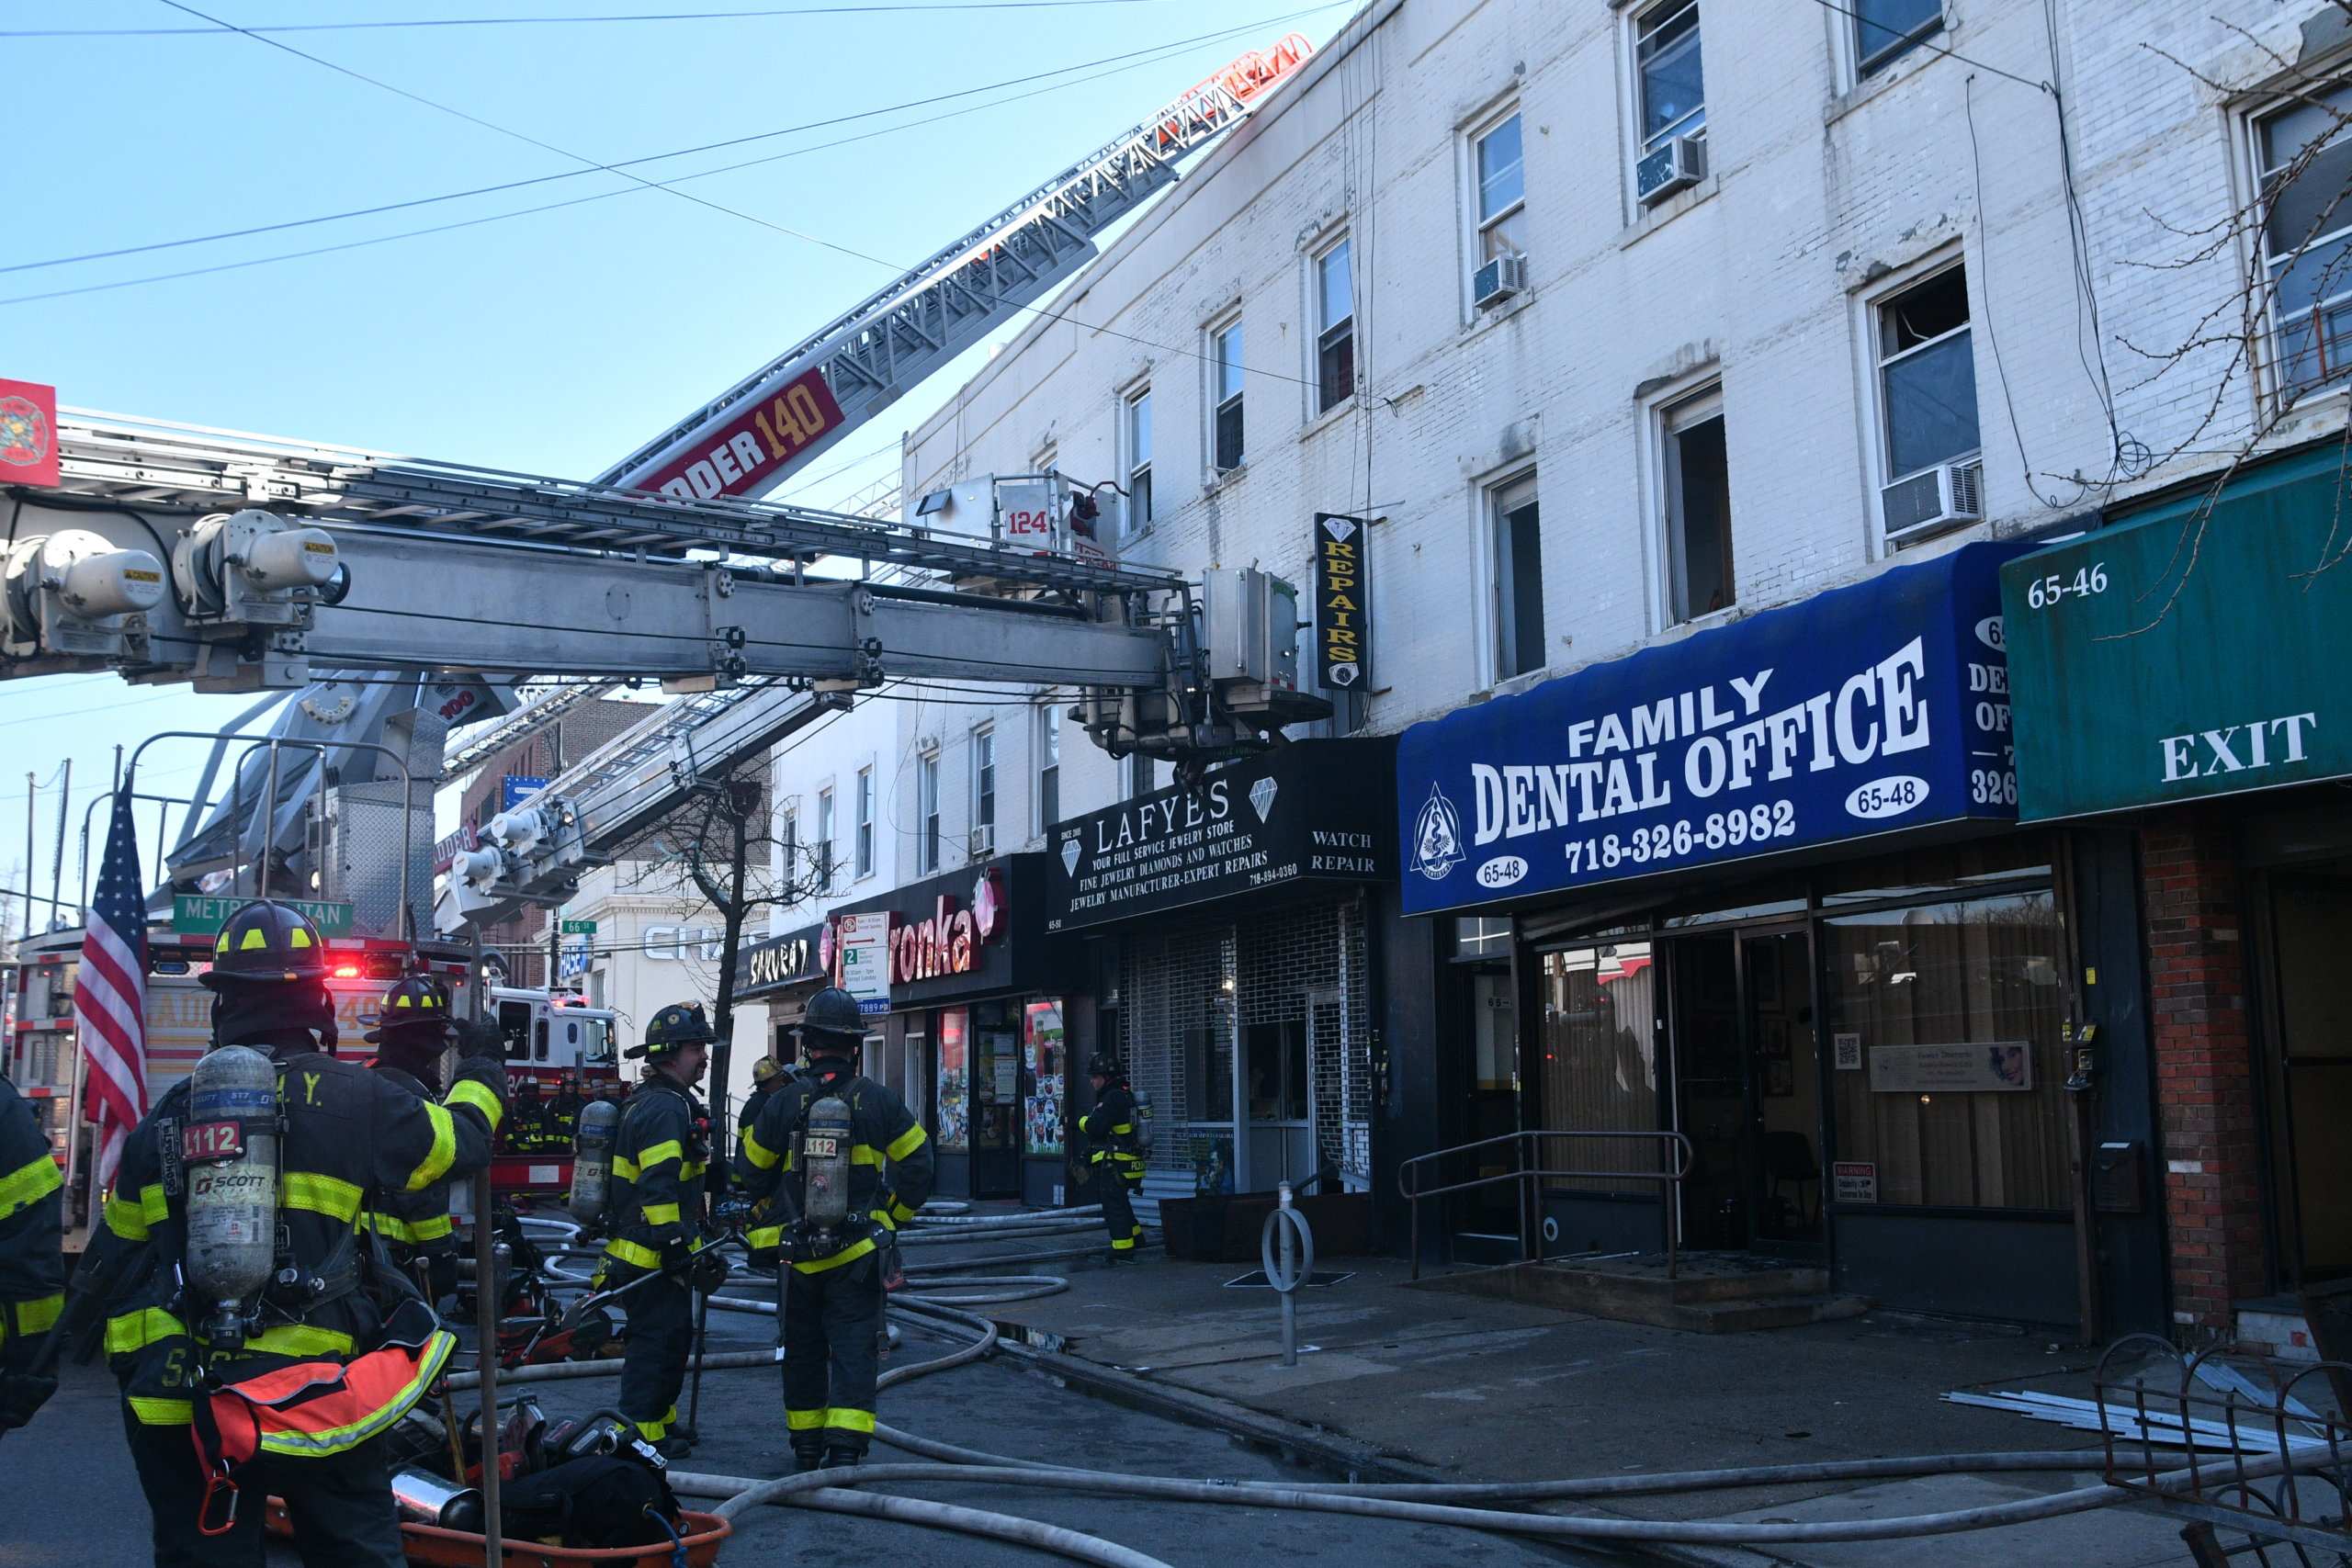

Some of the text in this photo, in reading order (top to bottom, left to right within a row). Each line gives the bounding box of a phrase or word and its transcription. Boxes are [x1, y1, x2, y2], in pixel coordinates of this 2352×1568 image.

[644, 383, 825, 505] DDER 140
[1009, 511, 1047, 535] 124
[2028, 562, 2108, 609] 65-46
[1325, 541, 1357, 661] REPAIRS
[438, 691, 474, 720] 100
[1569, 669, 1774, 758] FAMILY
[1472, 635, 1930, 846] DENTAL OFFICE
[2159, 713, 2316, 783] EXIT
[1858, 781, 1917, 815] 65-48
[1097, 779, 1229, 853] LAFYES
[1061, 830, 1072, 840] SINCE
[1092, 820, 1234, 872] YOUR FULL SERVICE JEWELRY STORE
[1313, 830, 1372, 848] WATCH
[1565, 799, 1795, 874] 718-326-8982
[1080, 833, 1252, 892] FINE JEWELRY DIAMONDS AND WATCHES
[1250, 863, 1297, 886] 718-894-0360
[1311, 855, 1374, 872] REPAIR
[1483, 860, 1521, 883] 65-48
[1069, 850, 1268, 913] JEWELRY MANUFACTURER-EXPERT REPAIRS
[186, 898, 341, 925] METRTAN
[1048, 919, 1061, 930] 65-50
[569, 922, 580, 931] 66
[847, 951, 854, 964] 2
[858, 1003, 878, 1012] 7889
[807, 1140, 834, 1154] L112
[215, 1176, 265, 1188] SCOTT
[1838, 1167, 1871, 1176] WARNING
